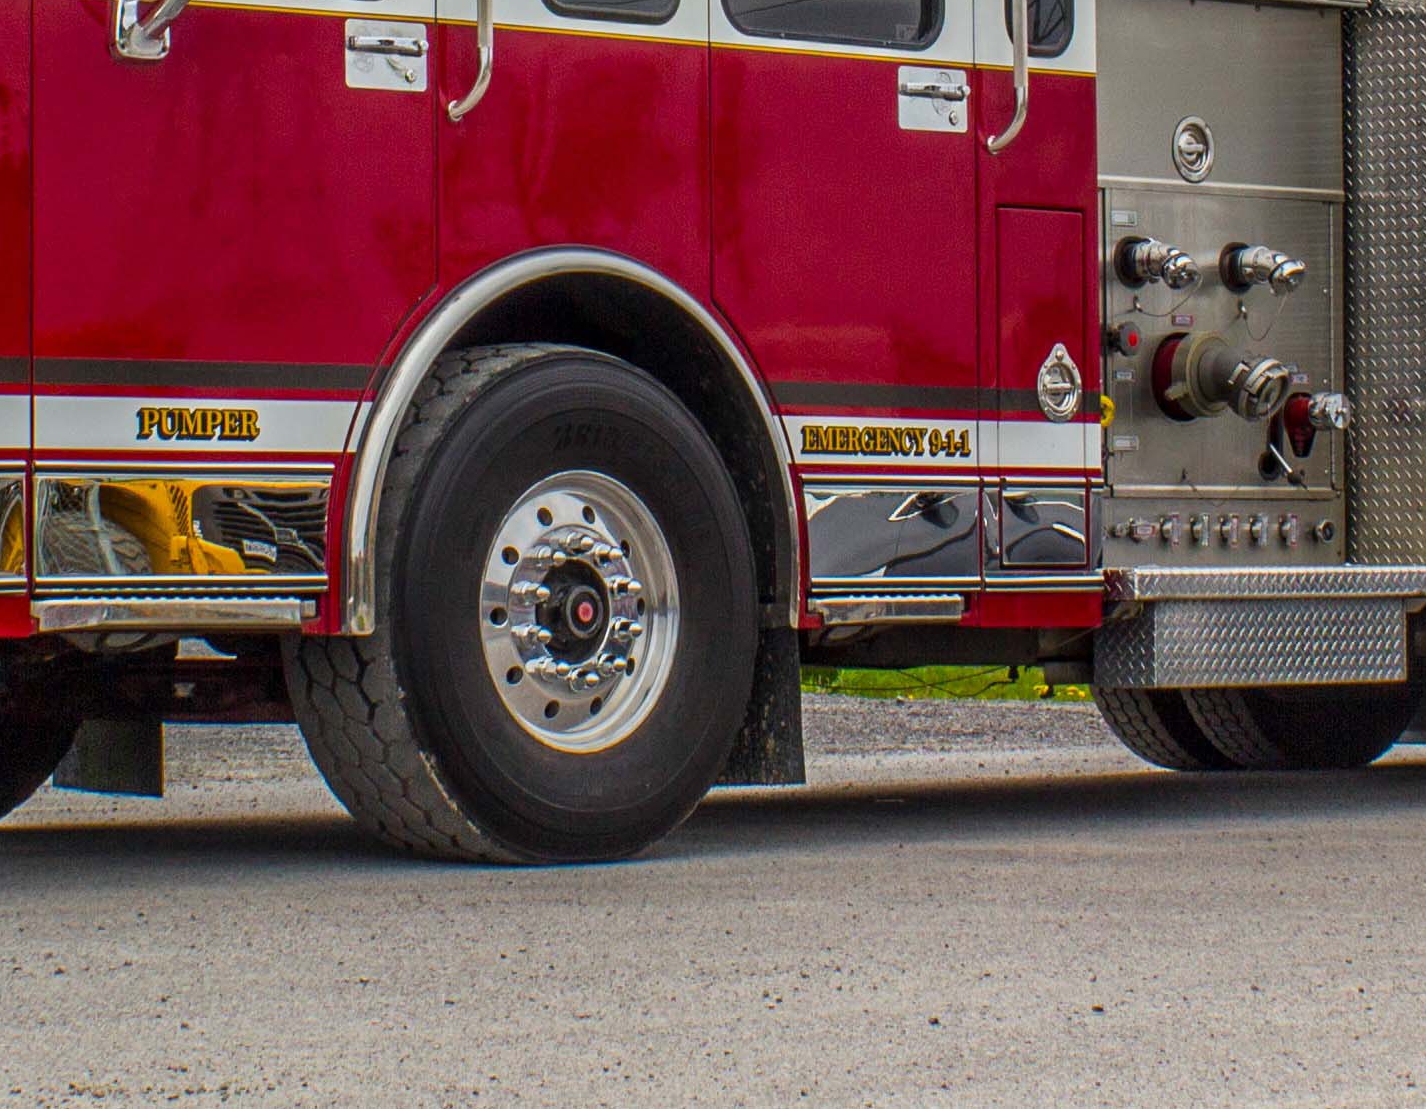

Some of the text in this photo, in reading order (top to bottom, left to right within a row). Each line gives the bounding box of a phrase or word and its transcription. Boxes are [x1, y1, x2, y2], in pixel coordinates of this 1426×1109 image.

[136, 407, 260, 441] PUMPER
[801, 425, 971, 458] EMERGENCY 9-1-1
